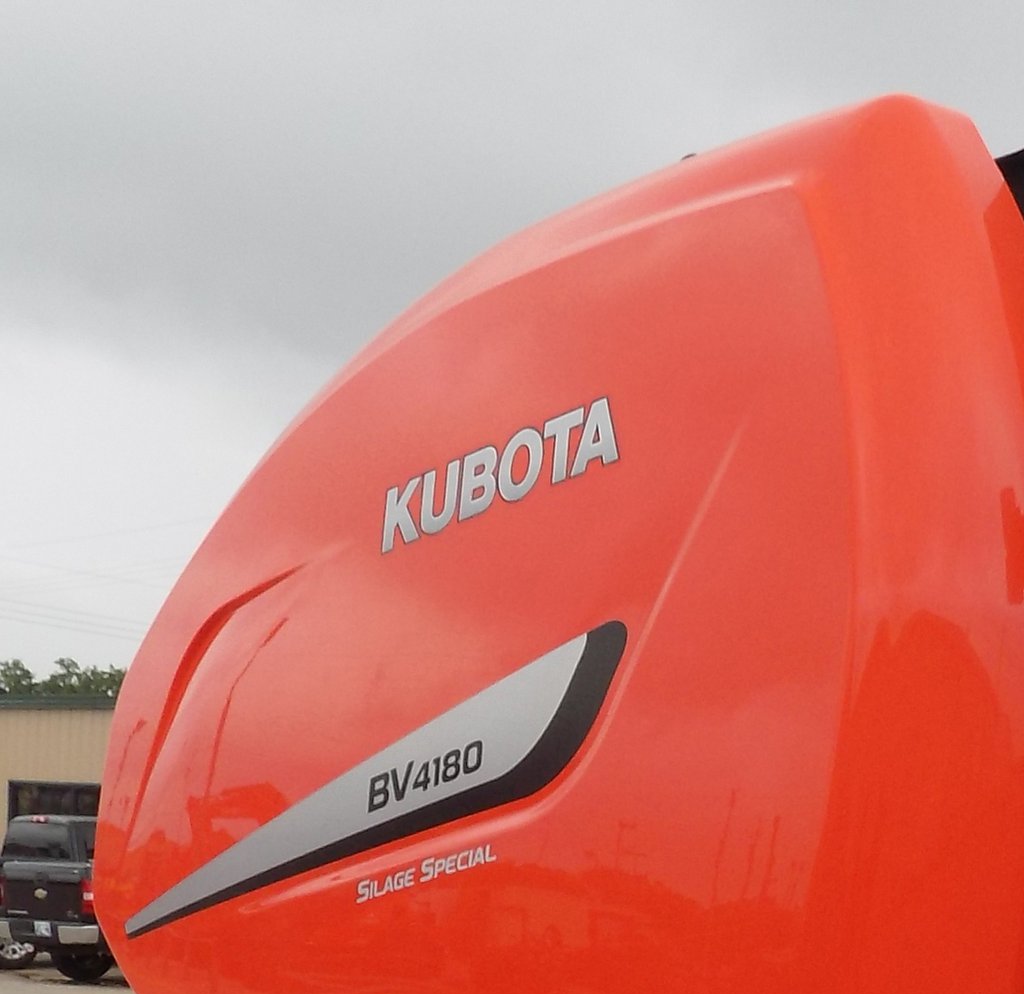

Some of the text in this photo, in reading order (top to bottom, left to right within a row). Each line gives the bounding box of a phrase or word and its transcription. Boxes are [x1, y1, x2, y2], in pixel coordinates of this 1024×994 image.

[381, 396, 620, 555] KUBOTA
[367, 740, 483, 813] BV4180
[355, 844, 497, 904] SILAGE SPECIAL
